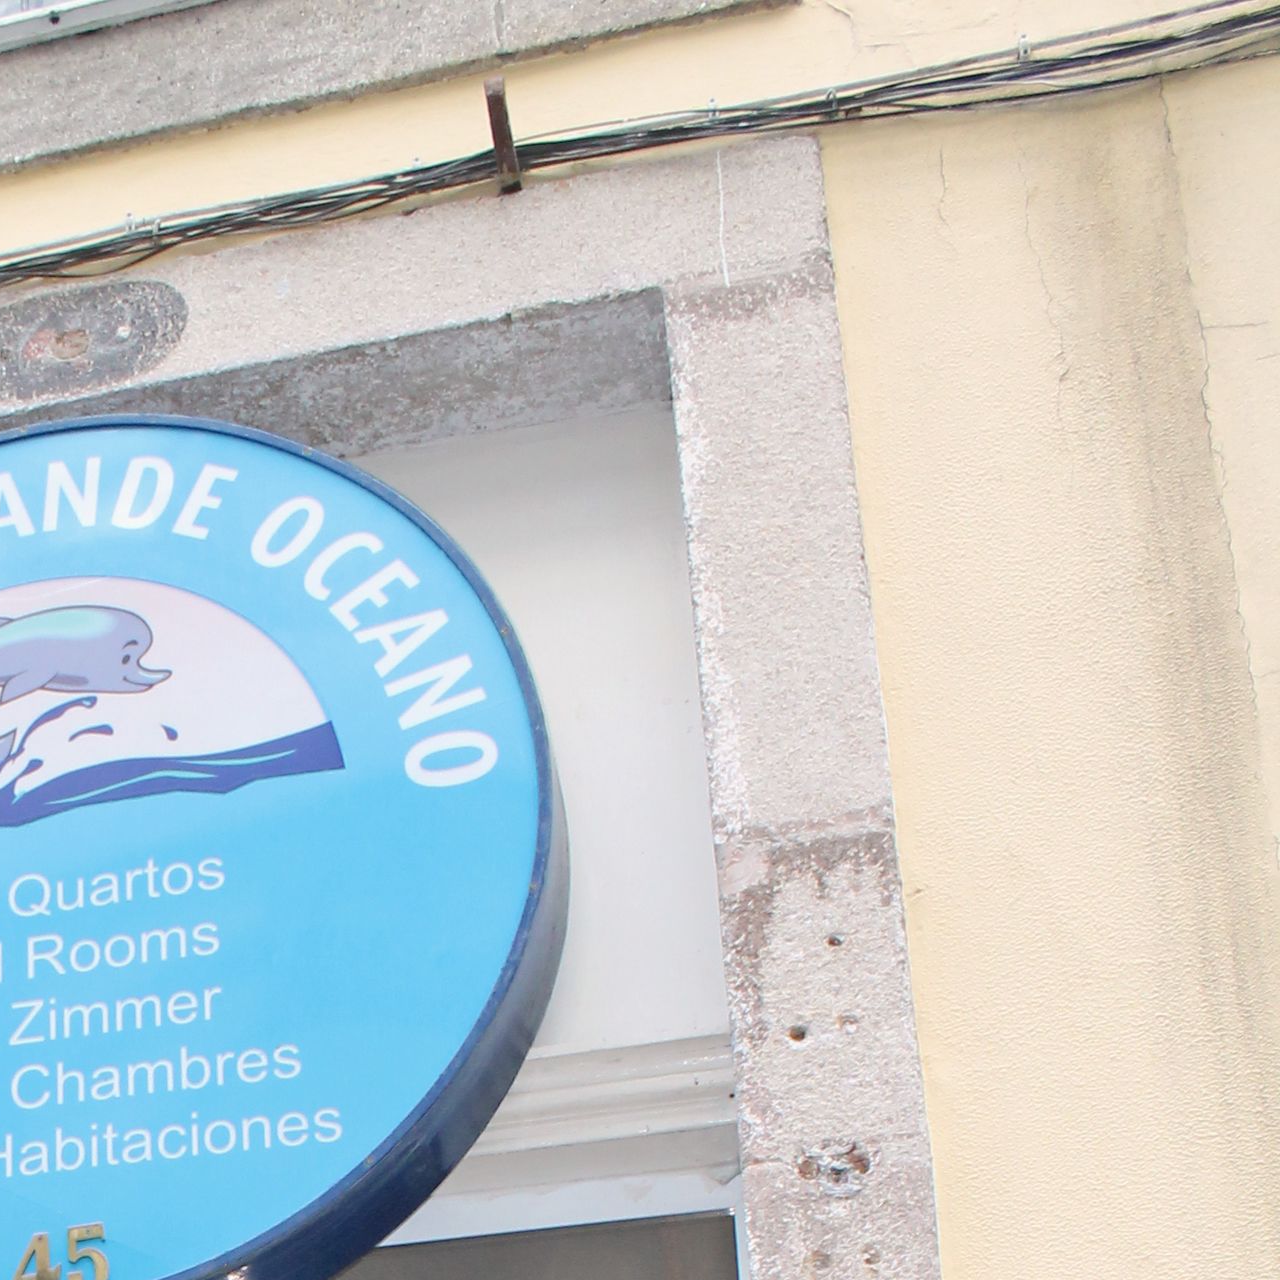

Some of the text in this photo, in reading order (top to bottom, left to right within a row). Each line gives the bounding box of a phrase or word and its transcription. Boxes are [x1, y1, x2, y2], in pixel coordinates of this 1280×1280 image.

[250, 496, 497, 788] OCEANO
[8, 857, 226, 917] Quartos
[26, 921, 221, 980] Rooms
[9, 985, 222, 1046] Zimmer
[11, 1043, 302, 1110] Chambres
